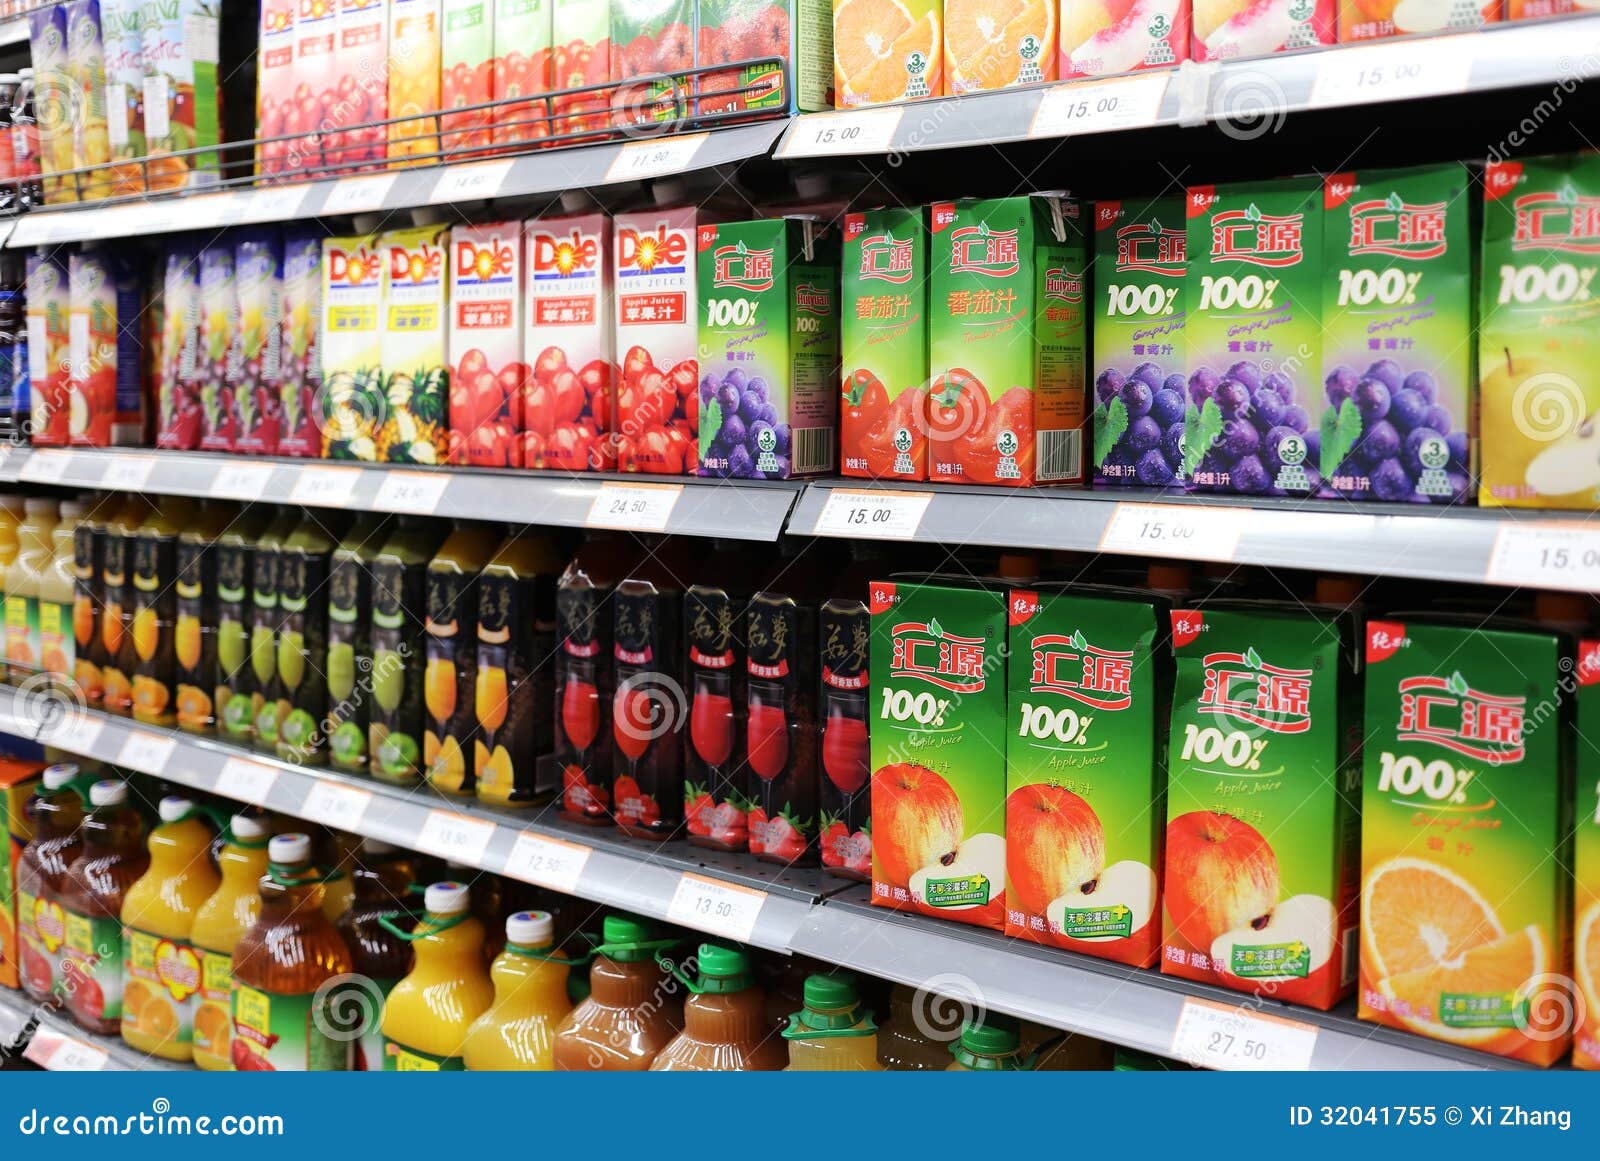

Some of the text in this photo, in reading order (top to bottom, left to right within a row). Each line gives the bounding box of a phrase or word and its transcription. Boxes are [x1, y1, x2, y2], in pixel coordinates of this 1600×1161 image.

[1153, 15, 1165, 30] 3
[1024, 37, 1035, 51] 3
[911, 53, 921, 67] 3
[1067, 97, 1118, 119] 15.00
[814, 126, 861, 145] 15.00
[1210, 223, 1302, 254] 汇源
[1349, 210, 1446, 247] 汇源
[390, 239, 441, 284] Dole
[457, 238, 514, 281] Dole
[533, 231, 598, 276] Dole
[618, 225, 687, 272] Dole
[861, 247, 913, 273] 汇源
[950, 235, 1019, 266] 汇源
[329, 243, 380, 286] Dole
[714, 253, 774, 281] 汇源
[1045, 277, 1082, 295] Huiyuan
[1199, 275, 1279, 311] 100%
[1337, 268, 1423, 306] 100%
[1498, 263, 1597, 304] 100%
[650, 297, 676, 305] Juice
[707, 298, 760, 327] 100%
[856, 293, 912, 320] 番茄汁
[948, 288, 1018, 317] 番茄汁
[1107, 284, 1178, 316] 100%
[542, 308, 590, 322] 苹果汁
[625, 306, 676, 321] 苹果汁
[763, 431, 771, 443] 3
[899, 430, 907, 443] 3
[1003, 433, 1012, 446] 3
[1287, 440, 1298, 454] 3
[1429, 442, 1440, 457] 3
[847, 508, 892, 525] 15.00
[1139, 521, 1195, 541] 15.00
[1540, 547, 1600, 572] 15.0
[874, 591, 902, 604] 纯果汁
[1013, 599, 1044, 615] 纯果汁
[890, 637, 985, 678] 汇源
[1029, 650, 1133, 695] 汇源
[1198, 668, 1312, 717] 汇源
[880, 687, 951, 727] 100%
[1018, 702, 1094, 746] 100%
[1397, 695, 1526, 747] 汇源
[908, 733, 964, 751] Apple Juice
[1179, 724, 1268, 771] 100%
[908, 755, 952, 774] 苹果汁
[1047, 752, 1107, 770] Apple Juice
[1047, 776, 1094, 796] 苹果汁
[1214, 778, 1283, 797] Apple Juice
[1377, 751, 1475, 805] 100%
[1209, 803, 1266, 824] 苹果汁
[1206, 1030, 1267, 1062] 27.50
